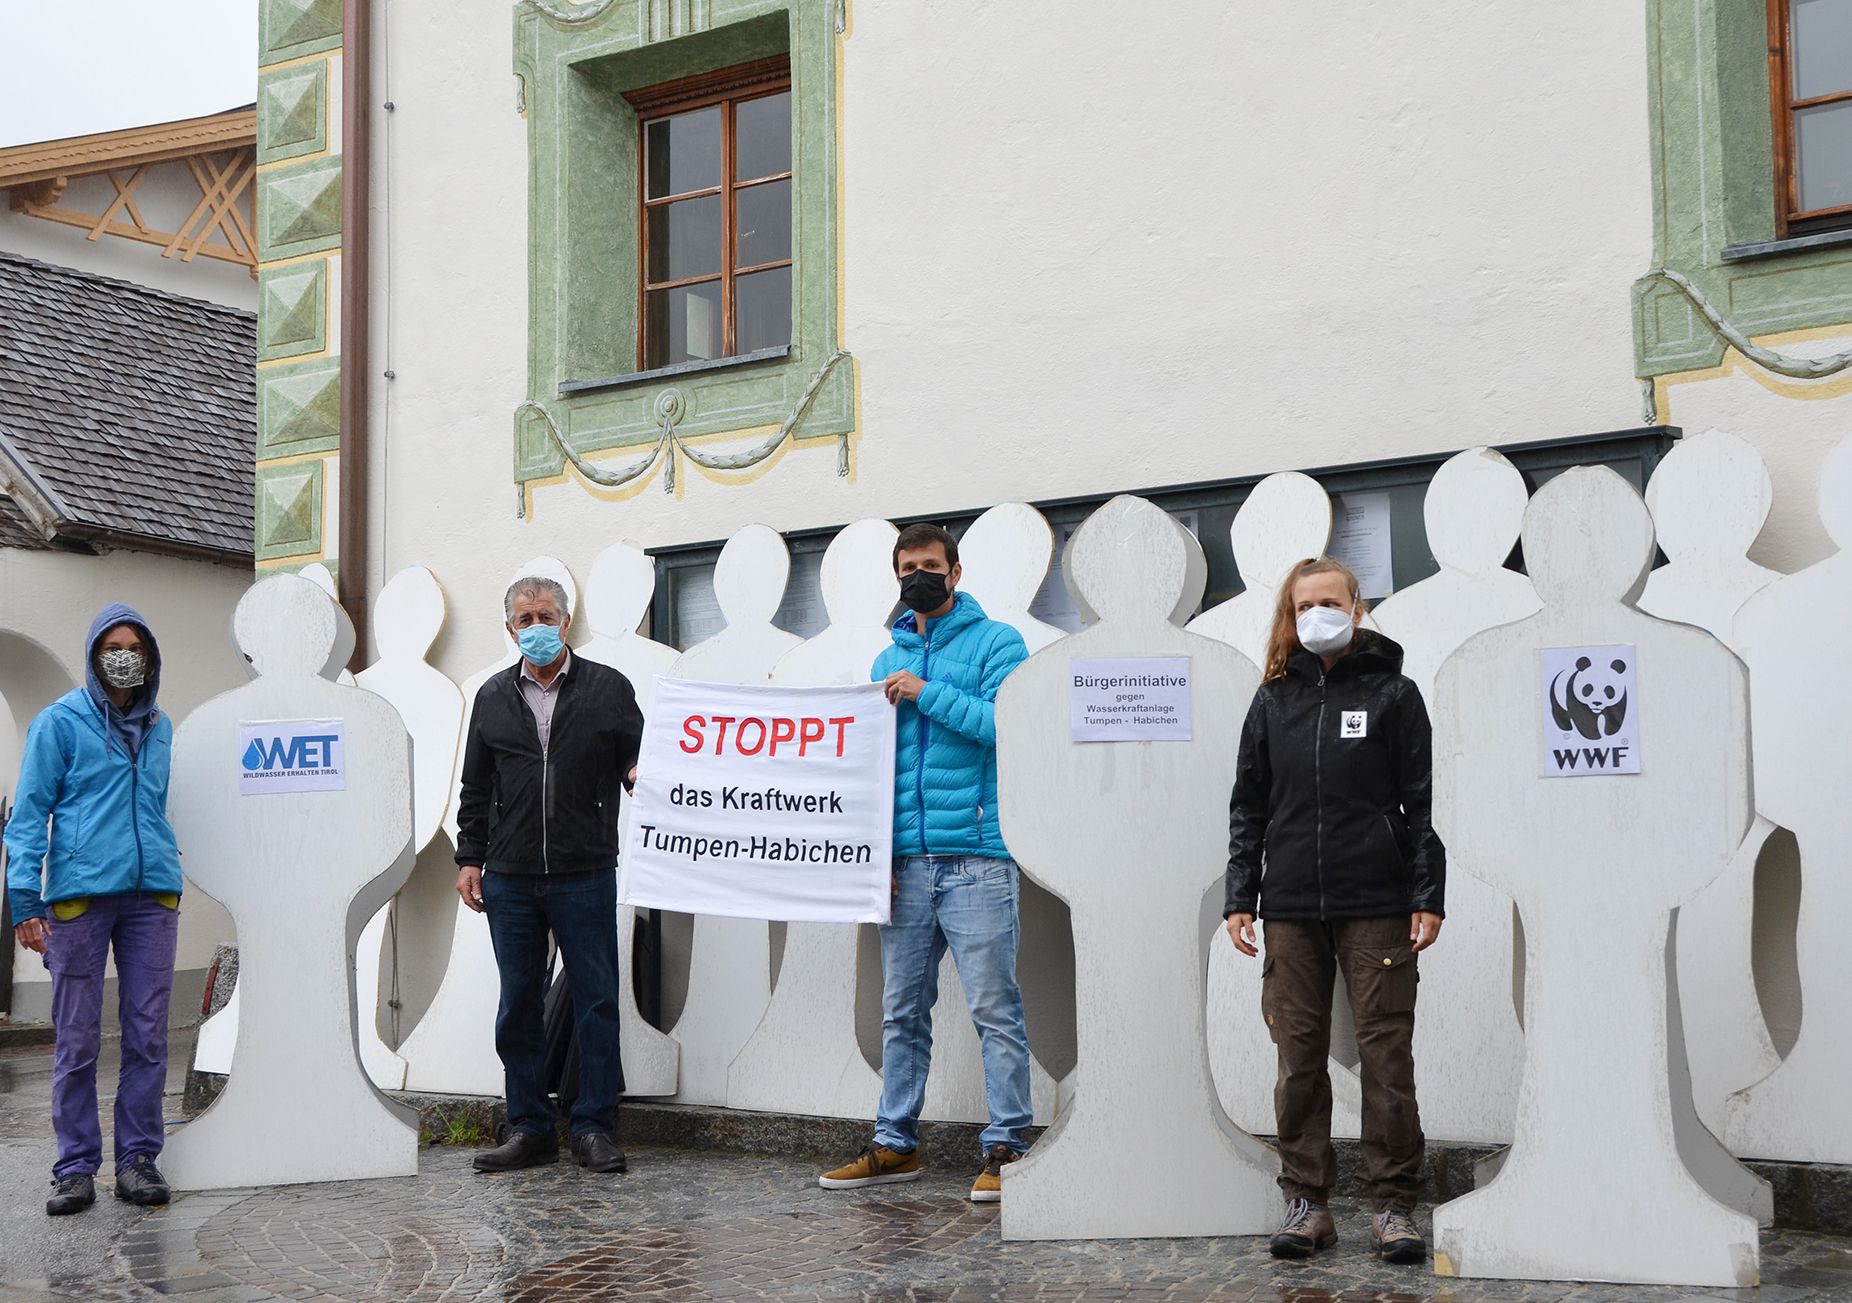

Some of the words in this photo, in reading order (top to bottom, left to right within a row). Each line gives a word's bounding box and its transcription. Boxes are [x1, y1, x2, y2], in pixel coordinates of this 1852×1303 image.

[1073, 675, 1187, 690] Bürgerinitiative
[1115, 694, 1145, 703] gegen
[1086, 704, 1175, 714] Wasserkraftanlage
[1083, 716, 1122, 726] Tumpen
[1133, 716, 1178, 724] Habichen
[679, 714, 855, 758] STOPPT
[253, 735, 339, 770] WET
[1552, 746, 1629, 770] WWF
[243, 771, 286, 779] WILDWASSER
[287, 769, 319, 777] ERHALTEN
[670, 783, 713, 808] das
[722, 786, 843, 814] Kraftwerk
[640, 824, 872, 864] Tumpen-Habichen
